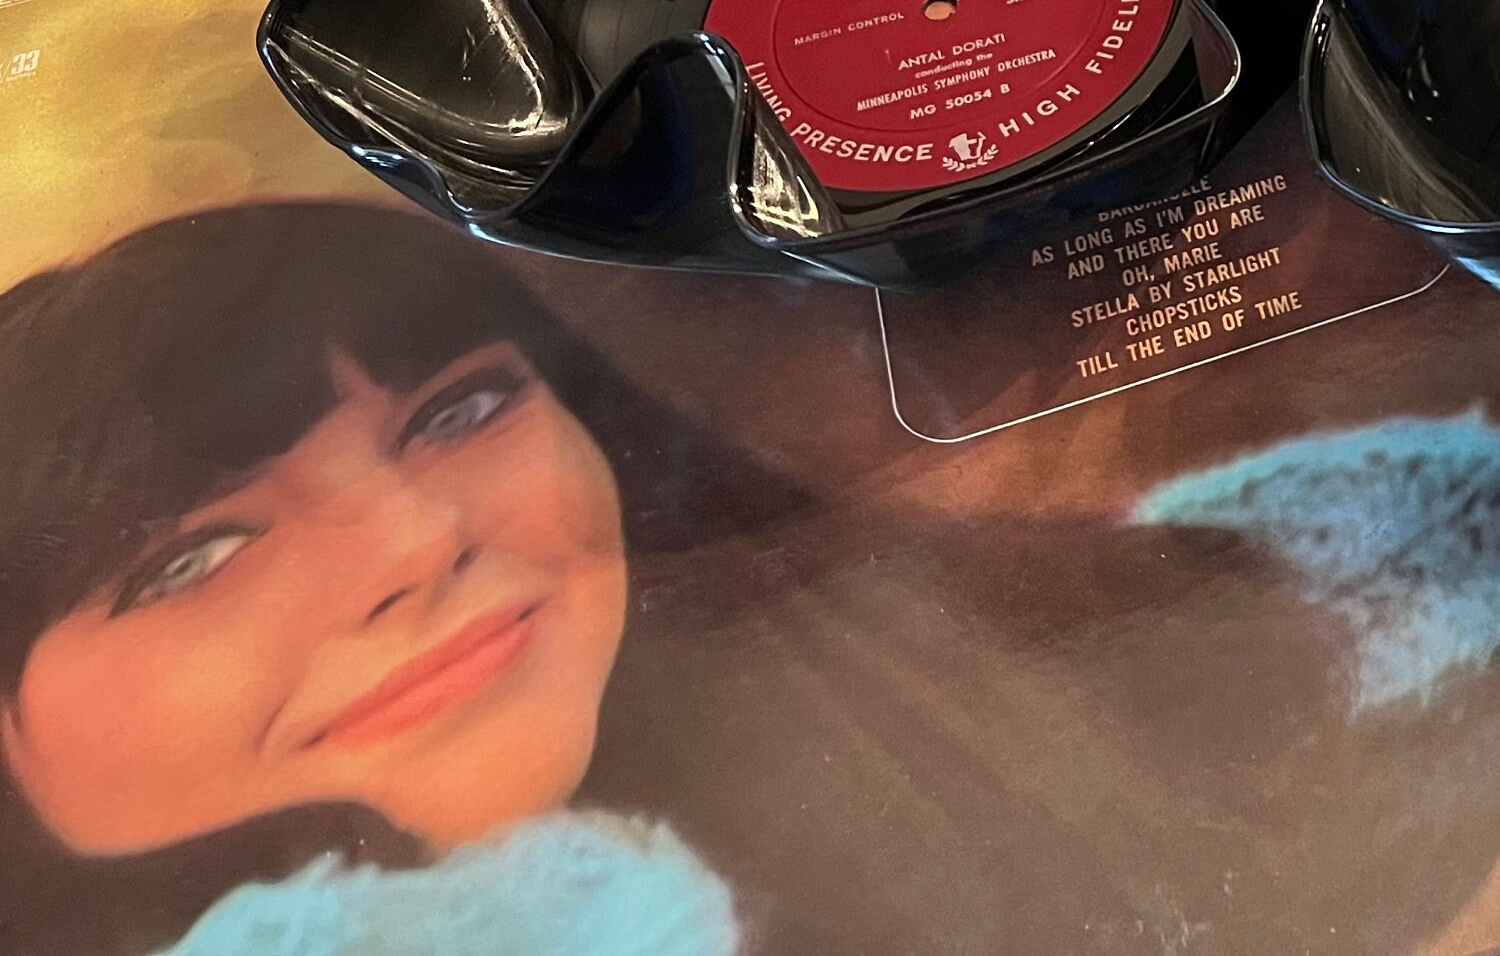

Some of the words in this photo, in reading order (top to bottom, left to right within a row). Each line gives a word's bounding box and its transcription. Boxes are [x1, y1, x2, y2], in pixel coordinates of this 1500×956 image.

[794, 25, 842, 46] MARGIN
[848, 11, 905, 33] CONTROL
[898, 46, 946, 71] ANTAL
[952, 32, 1006, 57] DORATI
[856, 82, 929, 112] MINNEAPOLIS
[934, 65, 991, 91] SYMPHONY
[997, 48, 1056, 73] ORCHESTRA
[914, 55, 974, 80] conducting
[976, 52, 993, 64] the
[745, 61, 791, 123] LIVING
[791, 122, 934, 162] PRESENCE
[999, 83, 1081, 138] HIGH
[910, 102, 937, 120] MG
[946, 88, 992, 109] 50054
[1001, 82, 1010, 95] B
[1031, 243, 1055, 266] AS
[1063, 228, 1114, 258] LONG
[1125, 217, 1147, 239] AS
[1156, 206, 1184, 228] I'M
[1194, 174, 1287, 216] DREAMING
[1067, 254, 1105, 280] AND
[1114, 232, 1174, 265] THERE
[1181, 218, 1219, 243] YOU
[1230, 205, 1265, 229] ARE
[1071, 294, 1140, 328] STELLA
[1149, 283, 1173, 305] BY
[1183, 247, 1282, 294] STARLIGHT
[1122, 264, 1155, 287] OH,
[1164, 242, 1222, 274] MARIE
[1076, 351, 1118, 378] TILL
[1127, 336, 1166, 363] THE
[1173, 322, 1212, 348] END
[1222, 309, 1246, 333] OF
[1255, 291, 1304, 320] TIME
[1126, 285, 1243, 337] CHOPSTICKS
